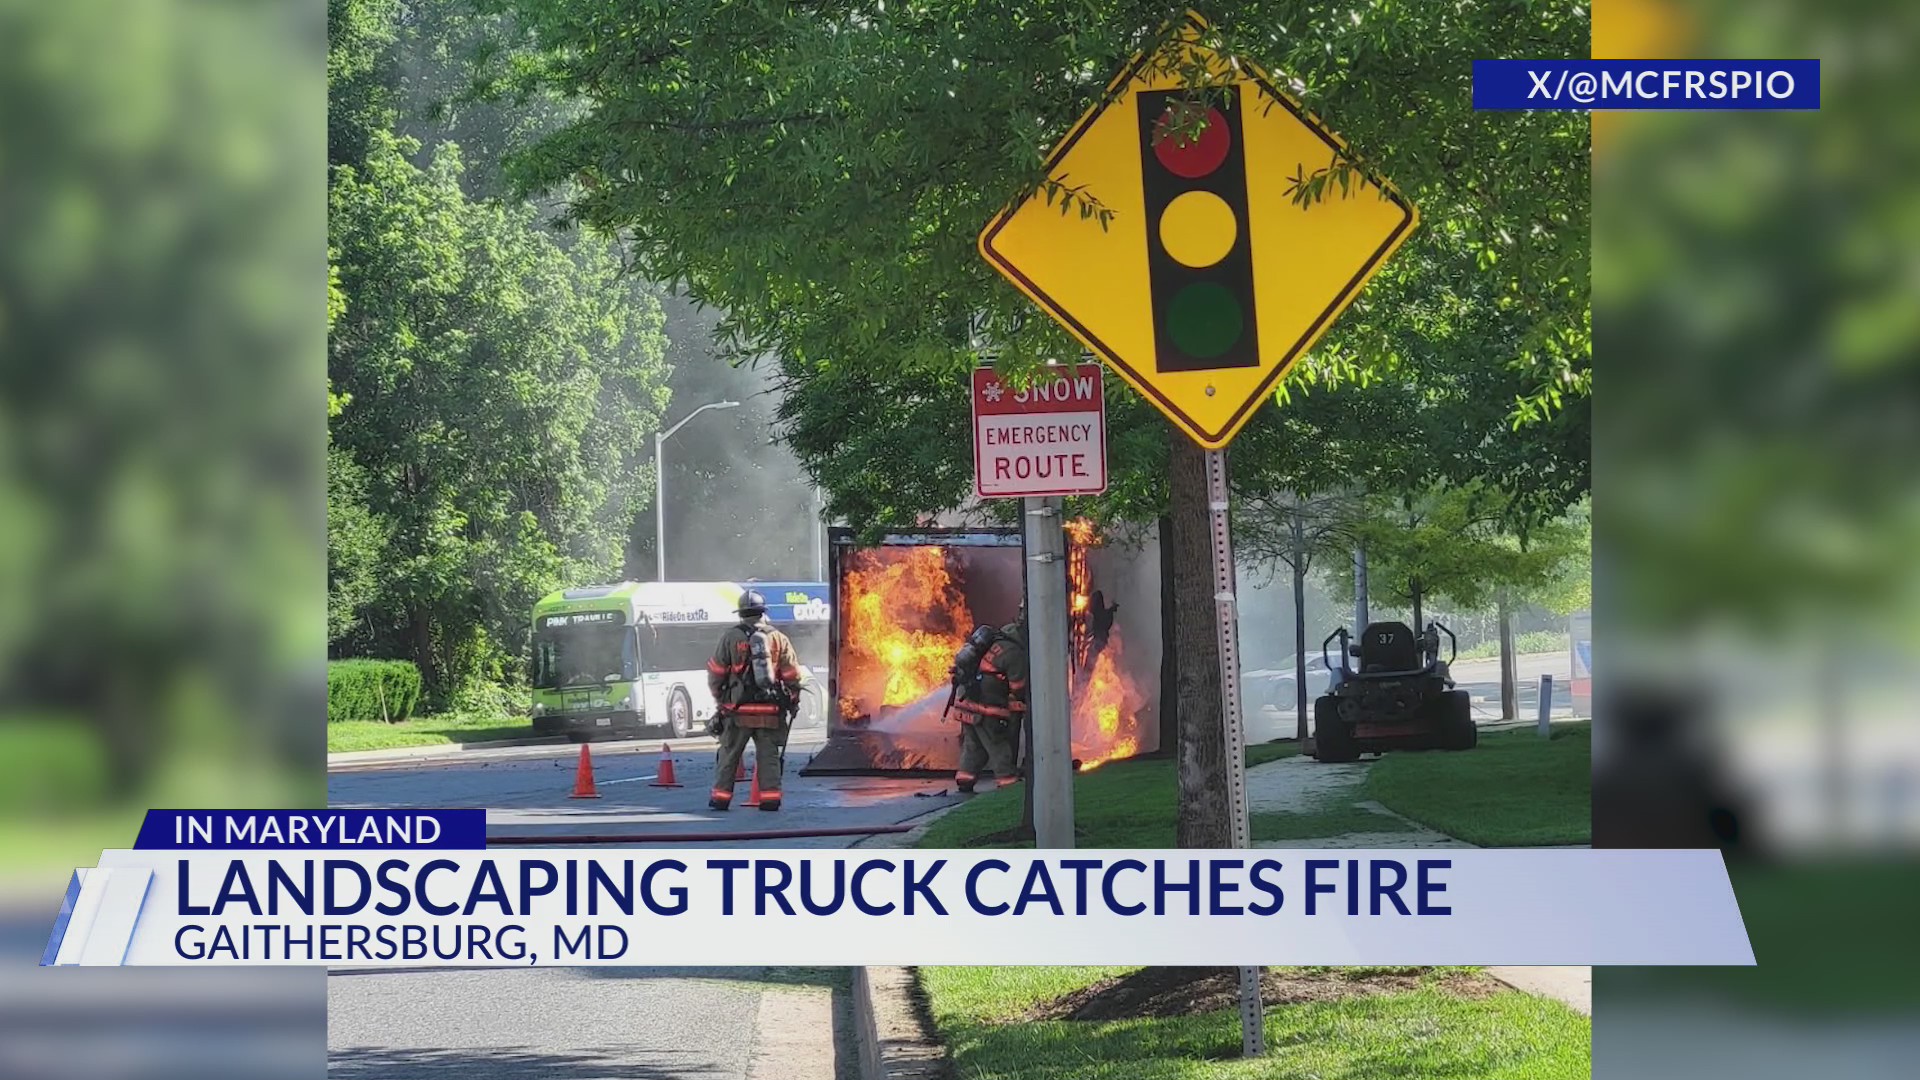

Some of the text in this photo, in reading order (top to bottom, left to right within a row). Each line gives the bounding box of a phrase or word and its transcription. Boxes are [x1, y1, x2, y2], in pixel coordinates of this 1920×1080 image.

[986, 424, 1091, 445] EMERGENCY
[995, 454, 1086, 480] ROUTE
[662, 611, 686, 622] RideOn
[1378, 632, 1394, 644] 37
